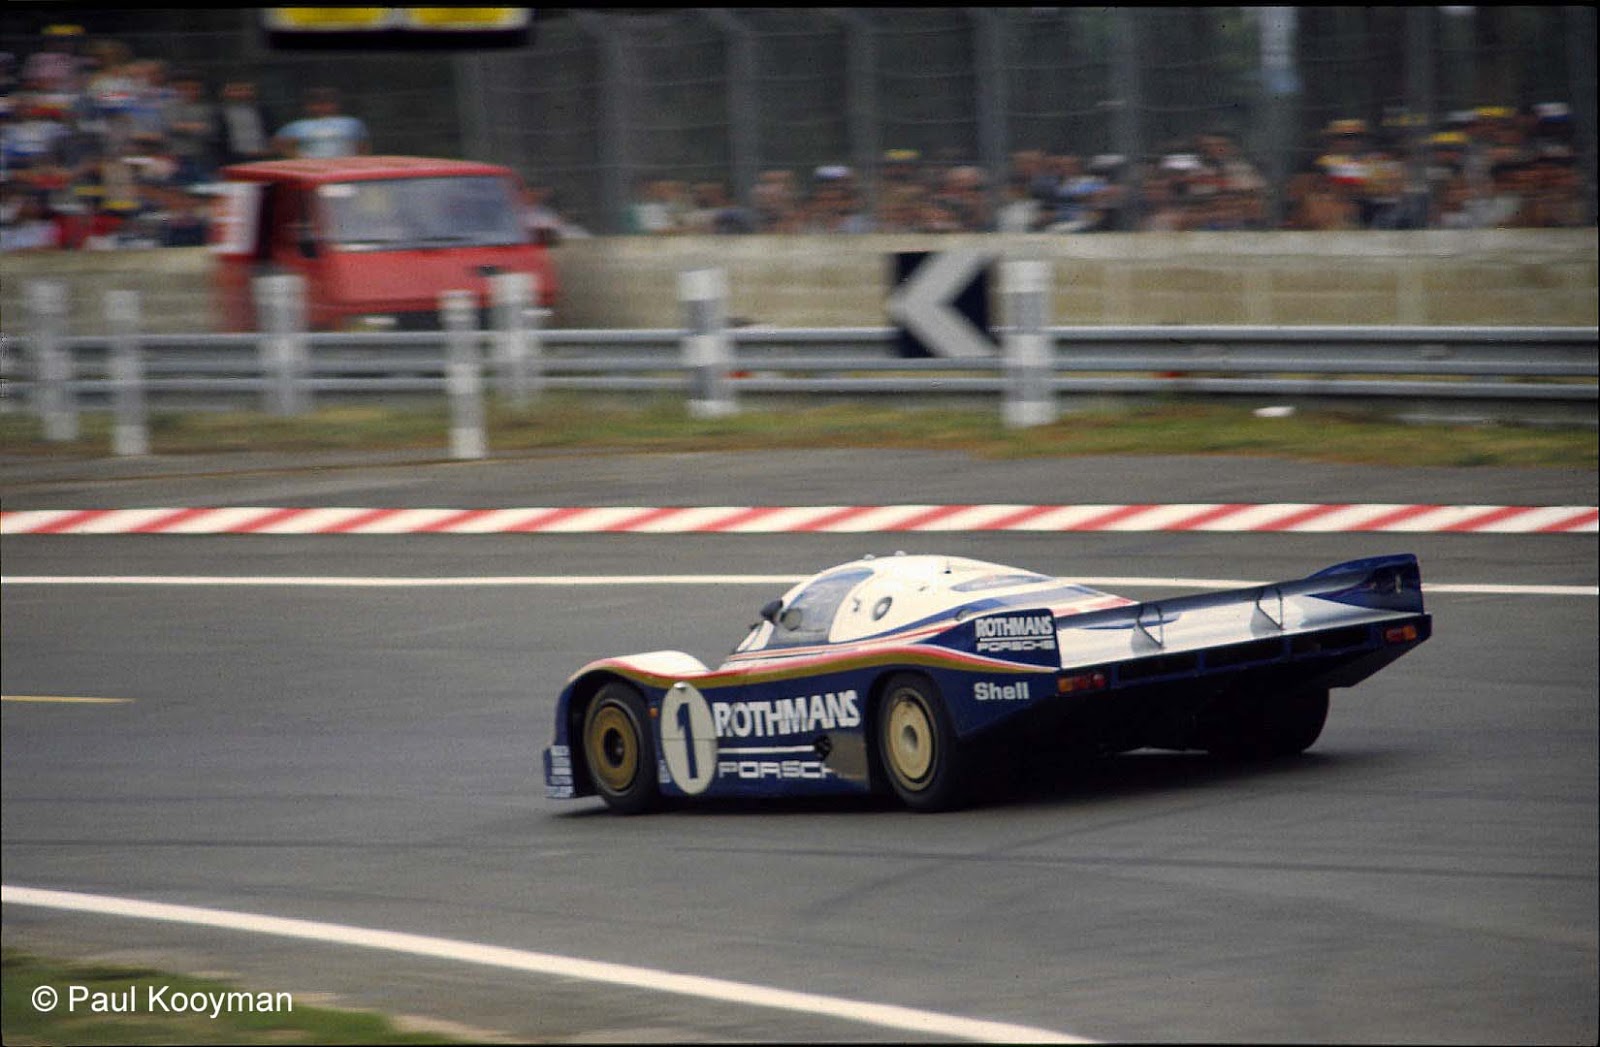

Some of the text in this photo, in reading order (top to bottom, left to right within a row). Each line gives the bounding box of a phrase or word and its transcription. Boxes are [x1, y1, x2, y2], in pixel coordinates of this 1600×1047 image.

[974, 615, 1054, 638] ROTHMANS
[976, 639, 1056, 652] PORSCHE
[974, 681, 1030, 700] Shell
[712, 690, 861, 738] ROTHMANS
[676, 702, 699, 779] 1
[718, 760, 836, 779] PORSCH
